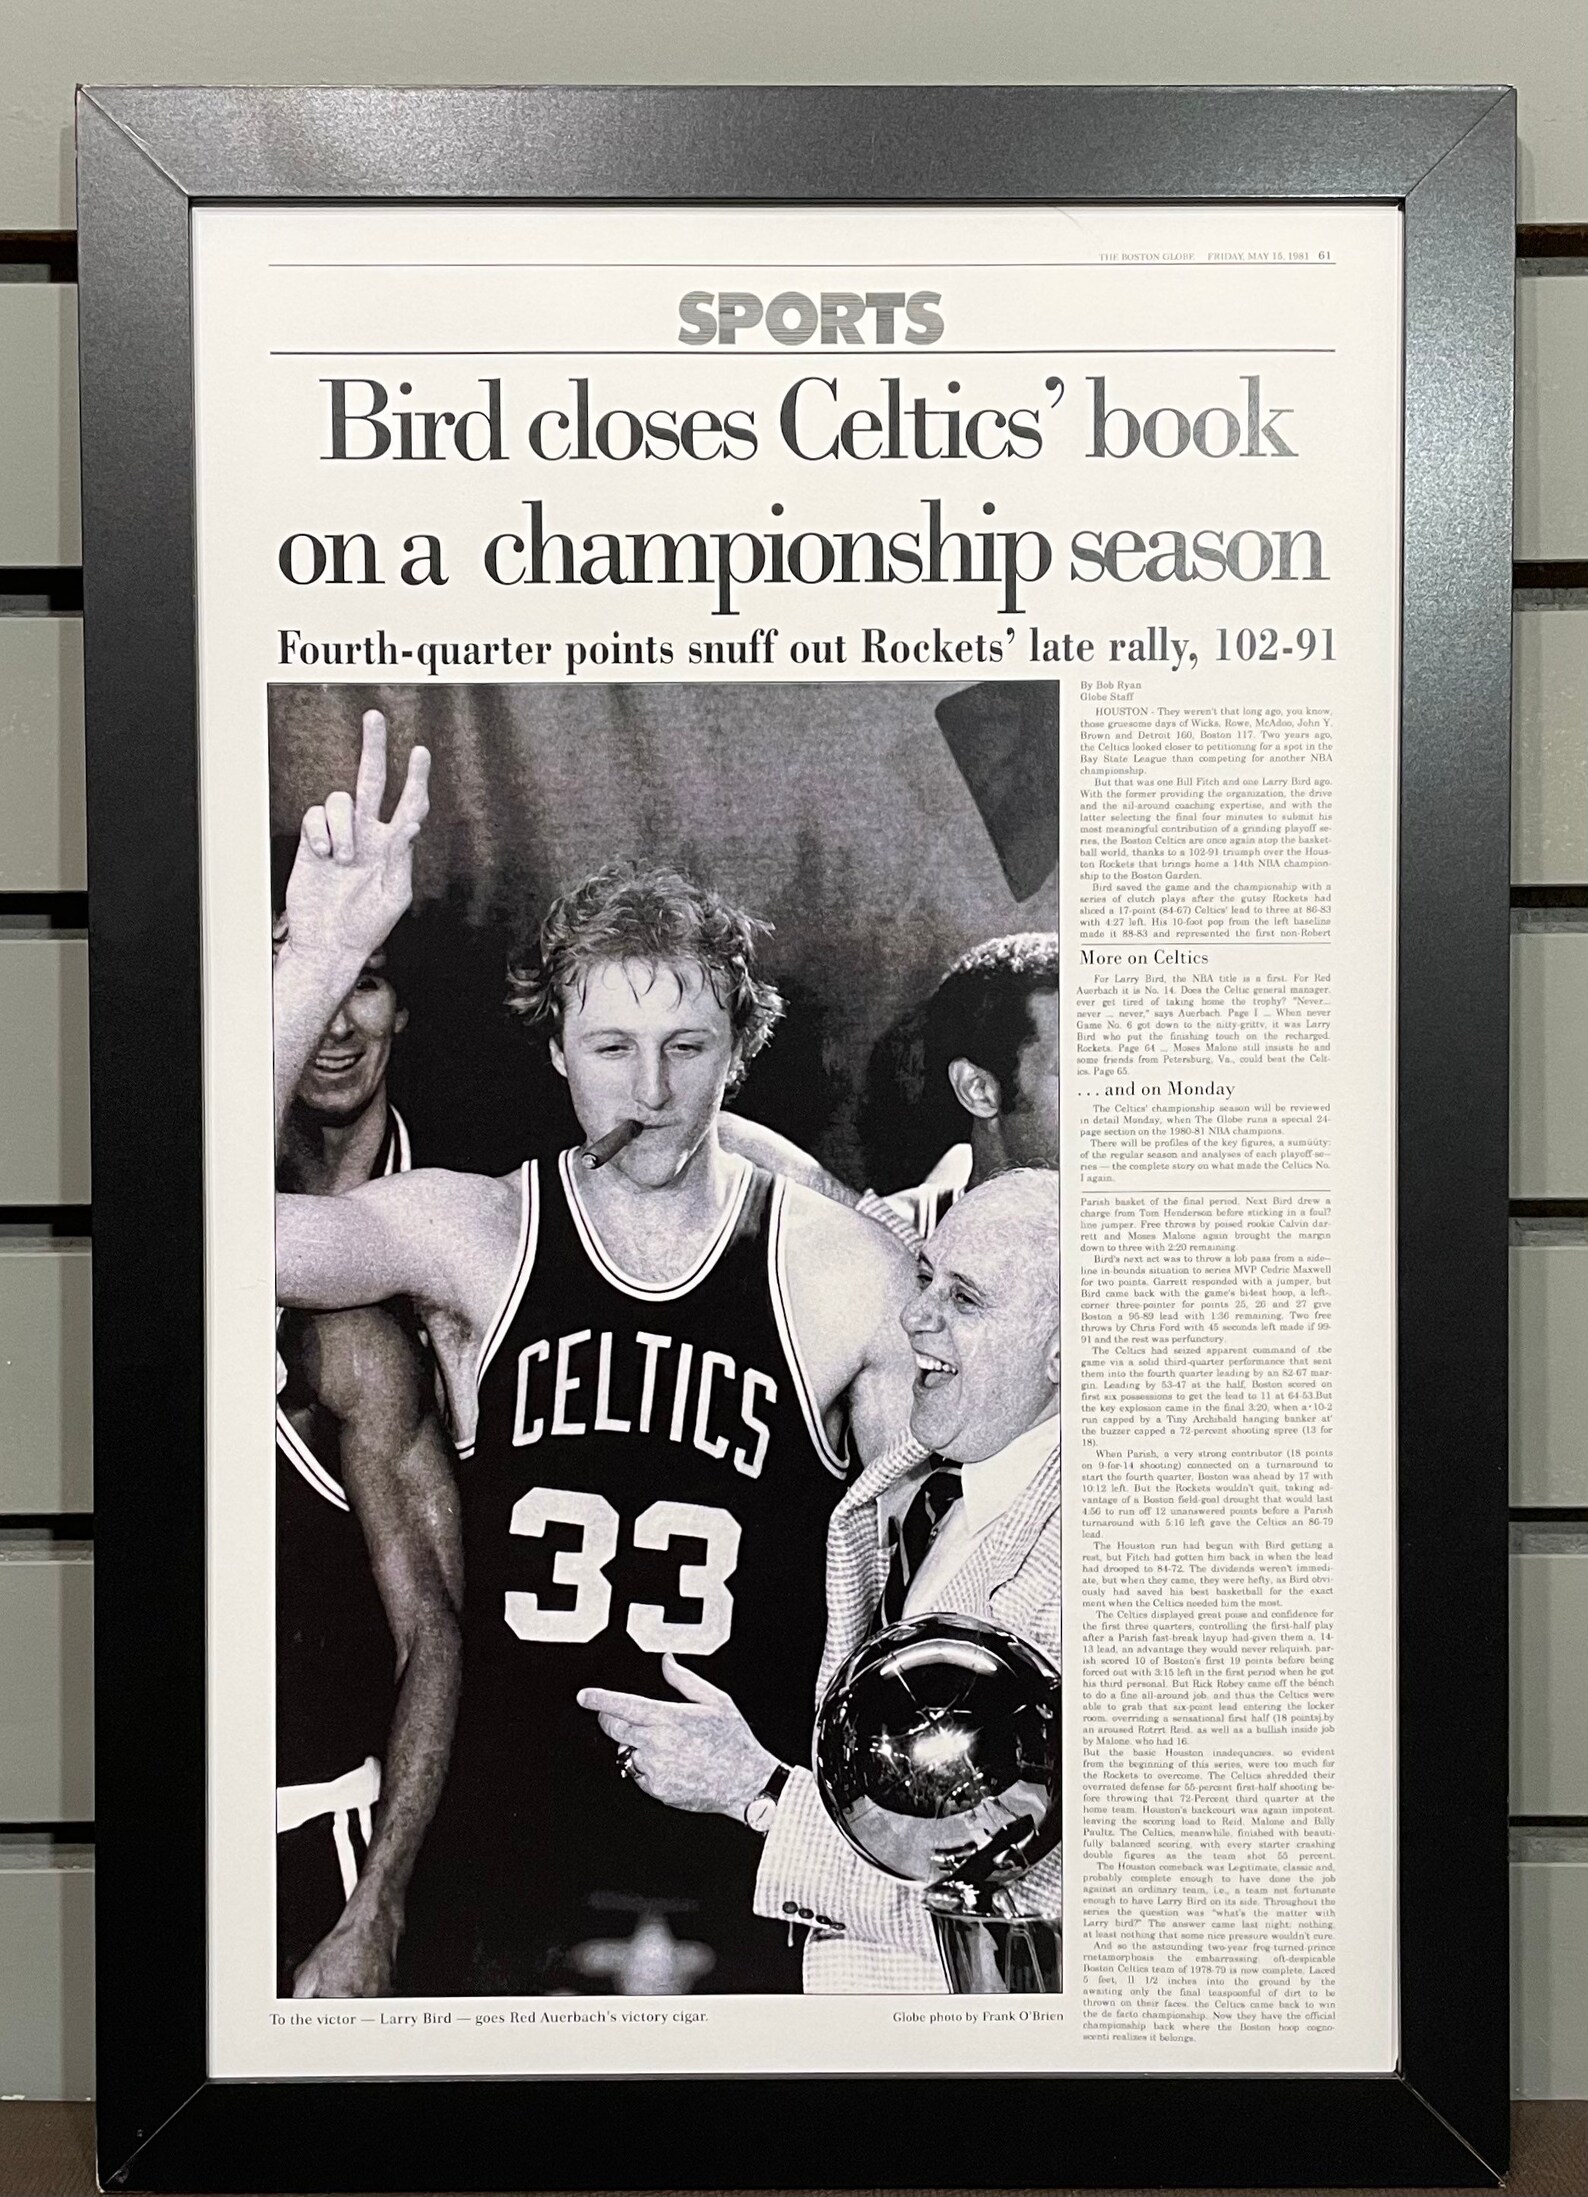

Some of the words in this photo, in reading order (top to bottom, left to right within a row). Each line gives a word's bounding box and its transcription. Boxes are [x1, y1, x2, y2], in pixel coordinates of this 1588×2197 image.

[1121, 252, 1159, 261] BOSTON
[1247, 252, 1269, 260] MAY
[1288, 251, 1309, 260] 1981
[1318, 250, 1331, 260] 61
[678, 290, 944, 345] SPORTS
[319, 378, 509, 461] Bird
[528, 378, 757, 460] closes
[780, 376, 1064, 460] Celtics'
[1085, 375, 1298, 458] book
[278, 533, 385, 584] on
[400, 534, 449, 585] a
[484, 498, 1051, 615] championship
[1071, 530, 1330, 582] season
[278, 629, 551, 675] Fourth-quarter
[566, 631, 673, 675] points
[689, 628, 778, 663] snuff
[790, 636, 846, 663] out
[862, 627, 1014, 662] Rockets'
[1030, 627, 1093, 661] late
[1109, 626, 1197, 671] rally,
[1216, 628, 1336, 660] 102-91
[1080, 680, 1092, 690] By
[1096, 680, 1114, 689] Bob
[1117, 680, 1141, 690] Ryan
[1080, 692, 1107, 701] Globe
[1110, 692, 1134, 701] Staff
[1096, 707, 1148, 716] HOUSTON
[1156, 706, 1180, 717] They
[1220, 706, 1239, 715] that
[1243, 706, 1262, 716] long
[1080, 754, 1098, 764] Bay
[1103, 754, 1128, 762] State
[1134, 754, 1166, 764] League
[1172, 754, 1193, 762] than
[1198, 755, 1246, 763] competing
[1252, 753, 1264, 762] for
[1269, 753, 1305, 762] another
[1310, 753, 1332, 762] NBA
[1080, 848, 1096, 856] ball
[1132, 847, 1164, 856] thanks
[1167, 848, 1176, 856] to
[1189, 847, 1218, 856] 102-91
[1222, 847, 1260, 857] triumph
[1286, 847, 1301, 855] the
[1080, 906, 1105, 914] sliced
[1119, 905, 1156, 916] 17-point
[1159, 906, 1191, 915] (84-67)
[1231, 905, 1249, 913] lead
[1266, 905, 1290, 913] three
[1306, 905, 1331, 913] 86-83
[1080, 950, 1121, 964] More
[1128, 955, 1146, 964] on
[1154, 949, 1208, 964] Celtics
[1105, 1081, 1134, 1095] and
[1141, 1086, 1160, 1095] on
[1168, 1081, 1234, 1100] Monday
[1080, 1129, 1101, 1137] page
[1152, 1127, 1166, 1135] the
[1170, 1126, 1204, 1134] 1980-81
[1208, 1126, 1230, 1135] NBA
[1104, 1232, 1120, 1240] and
[1128, 1231, 1156, 1240] Moses
[1162, 1231, 1196, 1239] Malone
[1234, 1231, 1270, 1240] brought
[1277, 1230, 1291, 1239] the
[512, 1329, 777, 1479] CELTICS
[1082, 1518, 1134, 1526] turnaround
[1139, 1518, 1160, 1526] with
[1165, 1518, 1184, 1526] 5:16
[1189, 1518, 1204, 1526] left
[1236, 1517, 1250, 1526] the
[1256, 1517, 1286, 1526] Celtics
[1308, 1517, 1333, 1525] 86-79
[1092, 1541, 1110, 1549] The
[1117, 1541, 1155, 1549] Houston
[1183, 1541, 1199, 1549] had
[1205, 1541, 1233, 1550] begun
[1239, 1540, 1259, 1549] with
[1265, 1540, 1284, 1549] Bird
[1290, 1541, 1322, 1550] getting
[504, 1486, 742, 1655] 33
[1083, 1839, 1104, 1850] fully
[1110, 1839, 1150, 1848] balanced
[1200, 1840, 1220, 1848] with
[1227, 1842, 1251, 1850] every
[1296, 1839, 1335, 1849] crashing
[1083, 1964, 1113, 1974] Boston
[1117, 1964, 1148, 1974] Celtics
[1178, 1964, 1187, 1973] of
[1191, 1965, 1226, 1973] 1978-79
[1309, 1966, 1335, 1974] Laced
[269, 2013, 285, 2025] To
[290, 2013, 312, 2024] the
[317, 2014, 356, 2024] victor
[380, 2013, 417, 2026] Larry
[423, 2012, 451, 2023] Bird
[475, 2015, 504, 2025] goes
[510, 2011, 535, 2023] Red
[622, 2011, 668, 2024] victory
[672, 2010, 708, 2024] cigar.
[893, 2011, 925, 2022] Globe
[930, 2011, 962, 2024] photo
[966, 2011, 978, 2024] by
[983, 2011, 1015, 2021] Frank
[1082, 2022, 1146, 2032] championship
[1153, 2022, 1174, 2032] back
[1182, 2022, 1210, 2030] where
[1217, 2022, 1232, 2031] the
[1240, 2022, 1270, 2031] Boston
[1278, 2022, 1299, 2032] hoop
